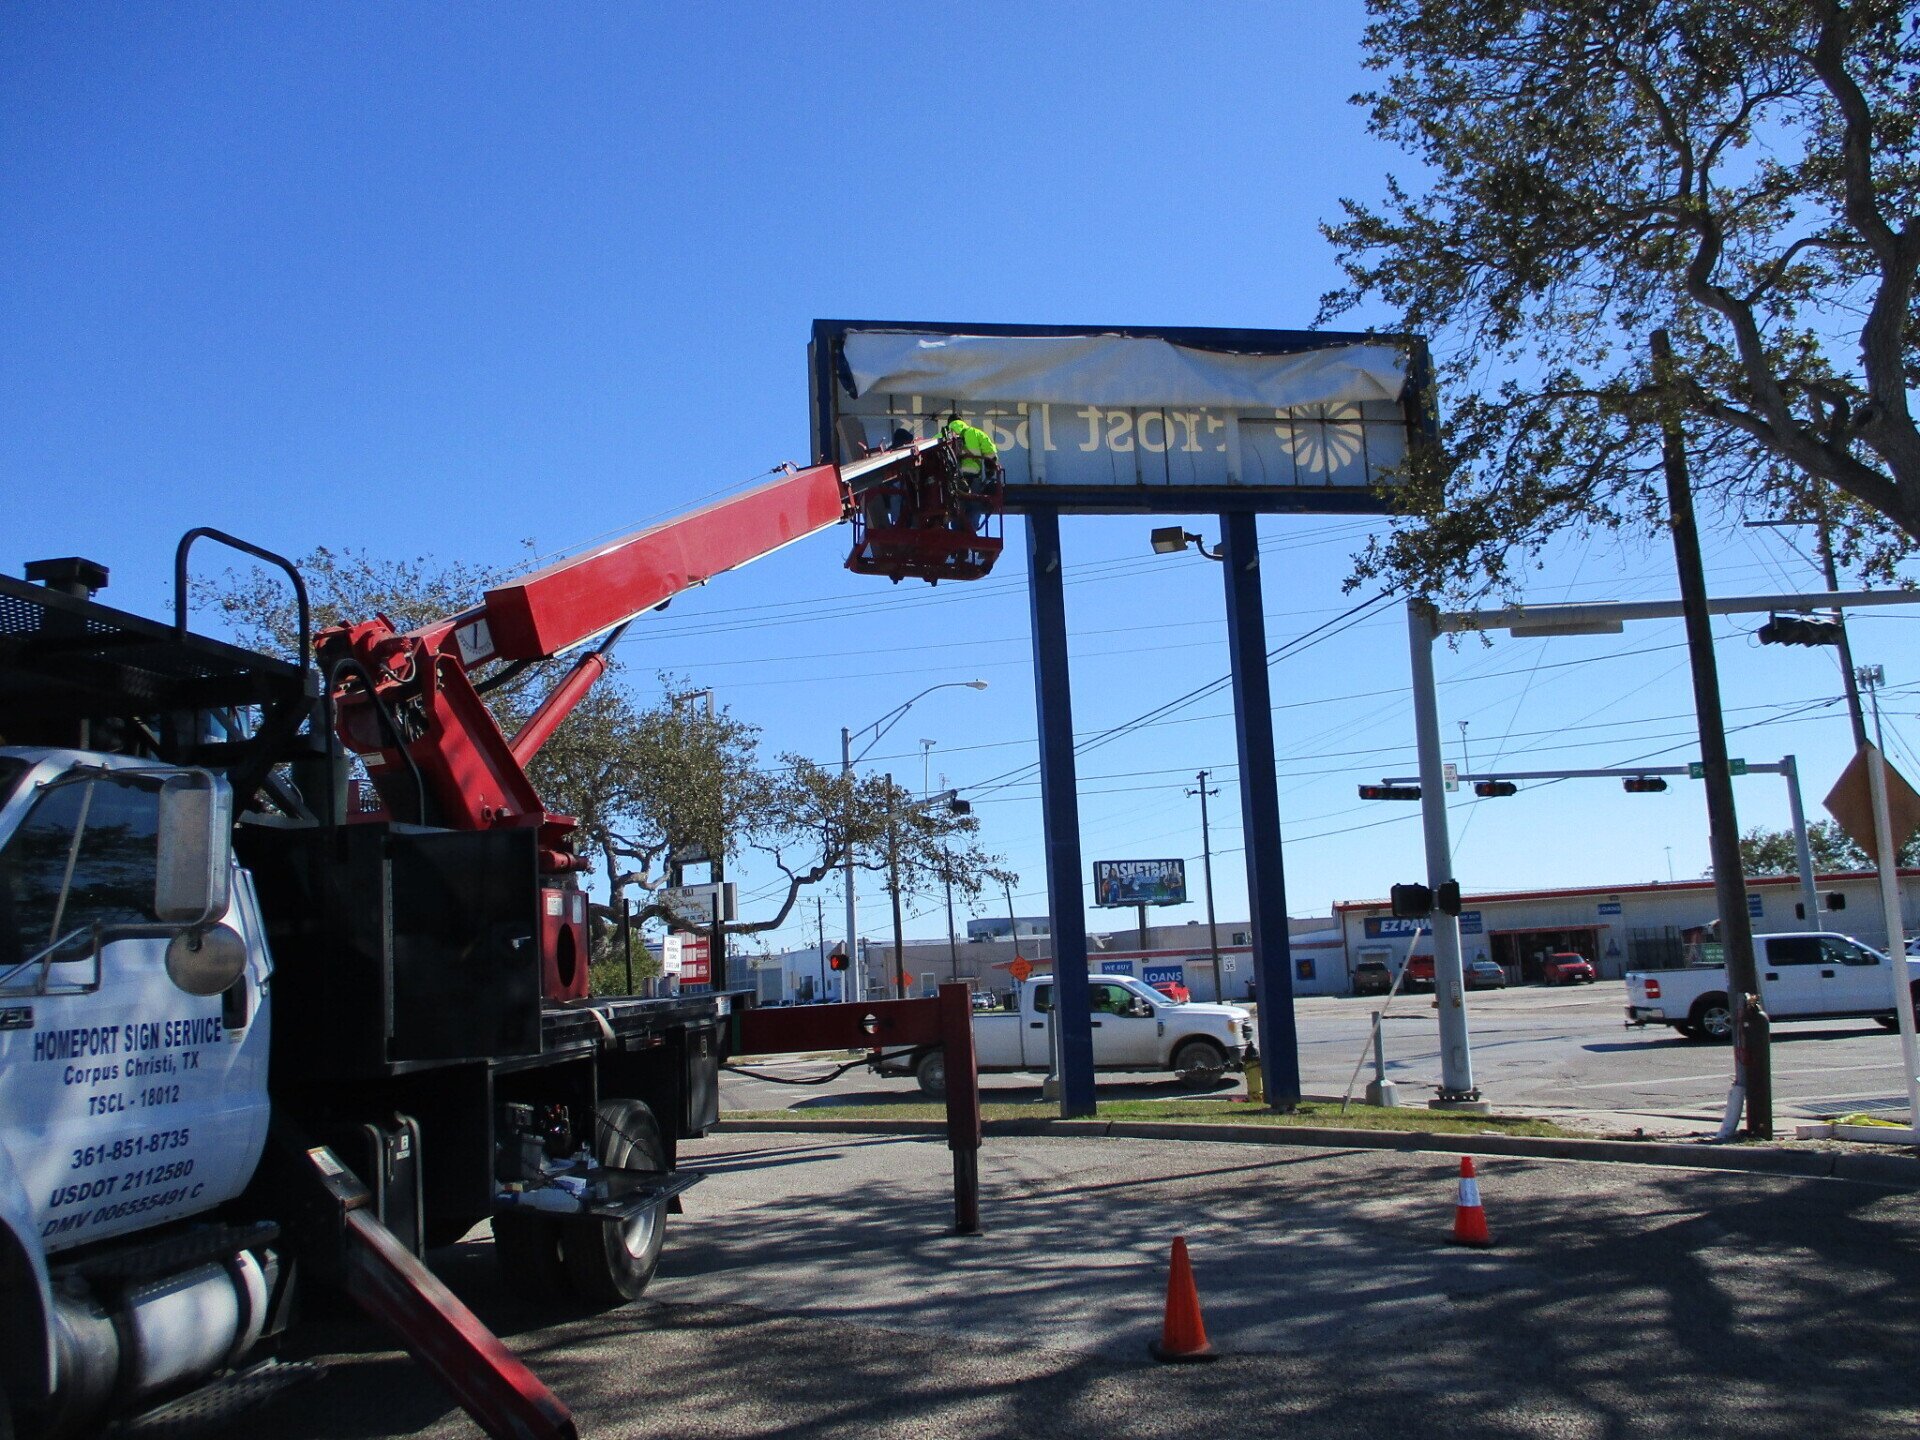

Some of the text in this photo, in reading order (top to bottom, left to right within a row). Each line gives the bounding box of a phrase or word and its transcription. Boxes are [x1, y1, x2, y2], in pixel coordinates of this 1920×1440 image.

[1101, 861, 1182, 879] BASKETBALL
[1144, 972, 1182, 982] LOANS
[1225, 963, 1235, 971] 35
[34, 1017, 222, 1062] HOMEPORT SIGN SERVICE
[64, 1051, 199, 1087] Corpus Christi, TX
[89, 1095, 125, 1116] TSCL
[141, 1085, 180, 1108] 18012
[71, 1129, 190, 1169] 361-851-8735
[50, 1159, 194, 1208] USDOT 2112580
[42, 1210, 92, 1238] DMV
[190, 1183, 204, 1200] C
